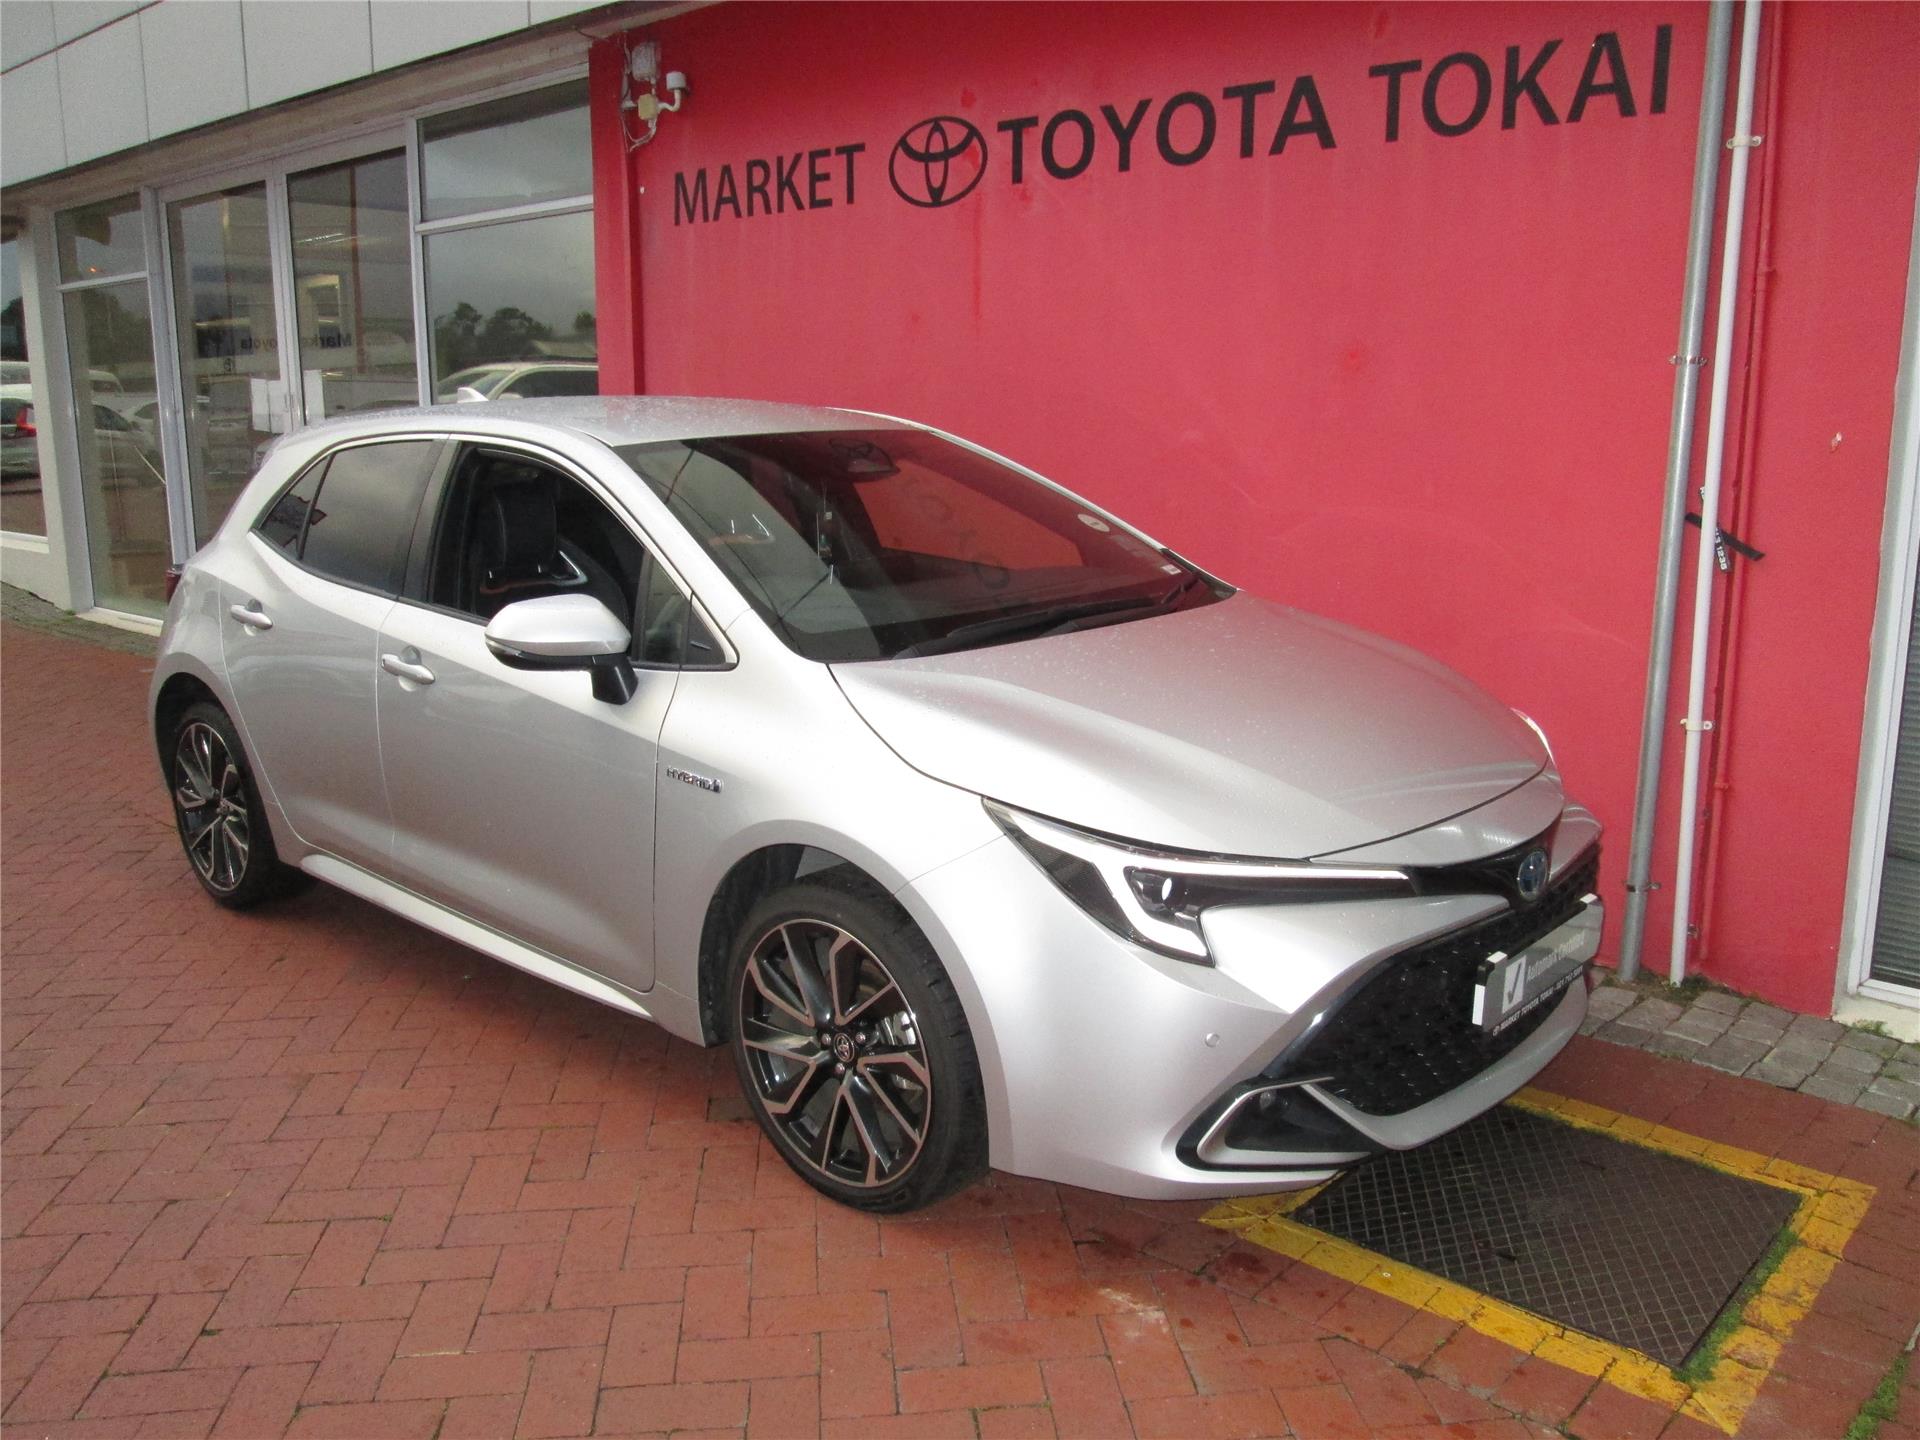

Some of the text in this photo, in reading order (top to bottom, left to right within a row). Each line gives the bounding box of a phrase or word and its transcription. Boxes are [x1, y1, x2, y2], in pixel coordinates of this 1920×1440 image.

[674, 23, 1673, 227] MARKET TOYOTA TOKAI
[666, 768, 712, 790] HYBRID
[1500, 1010, 1521, 1032] MARKET
[1521, 996, 1540, 1016] TOYOTA
